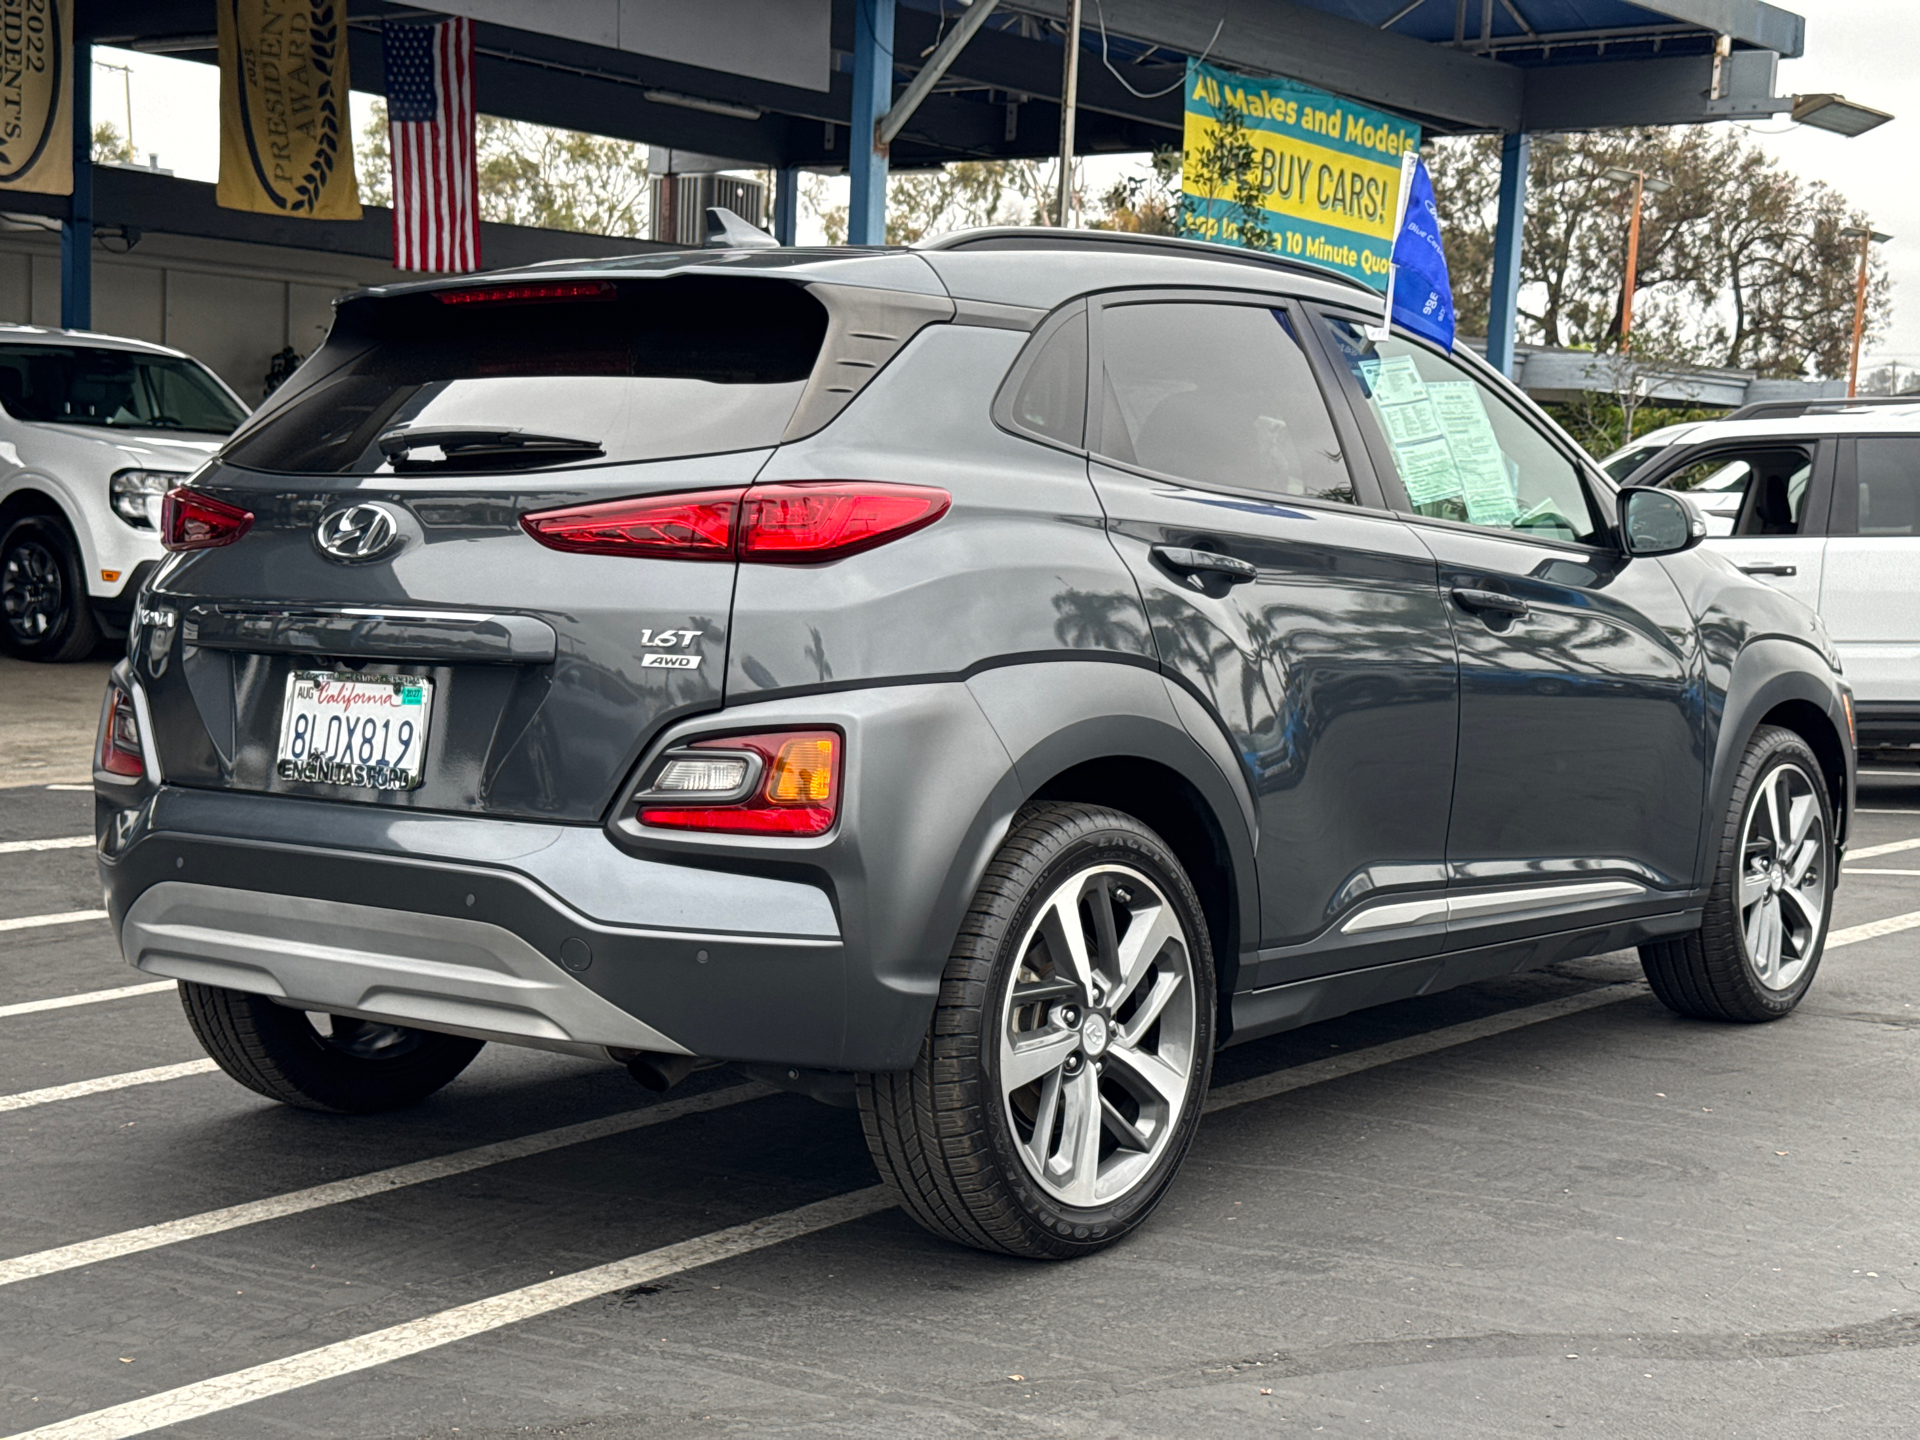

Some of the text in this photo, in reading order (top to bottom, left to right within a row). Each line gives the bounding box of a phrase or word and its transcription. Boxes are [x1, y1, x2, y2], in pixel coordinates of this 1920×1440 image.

[26, 0, 45, 73] 2022
[261, 0, 293, 184] PRESIDEN
[288, 13, 318, 141] AWARD
[1192, 75, 1414, 158] All Makes and Models
[1260, 147, 1312, 204] BUY
[1317, 163, 1388, 225] CARS!
[1222, 217, 1239, 241] In
[1286, 230, 1303, 255] 10
[1306, 235, 1358, 267] Minute
[1361, 249, 1391, 276] Quo
[1407, 221, 1427, 238] Blue
[648, 656, 691, 667] AWD
[297, 686, 314, 699] AUG
[317, 680, 402, 713] California
[1098, 835, 1167, 866] EAGLE
